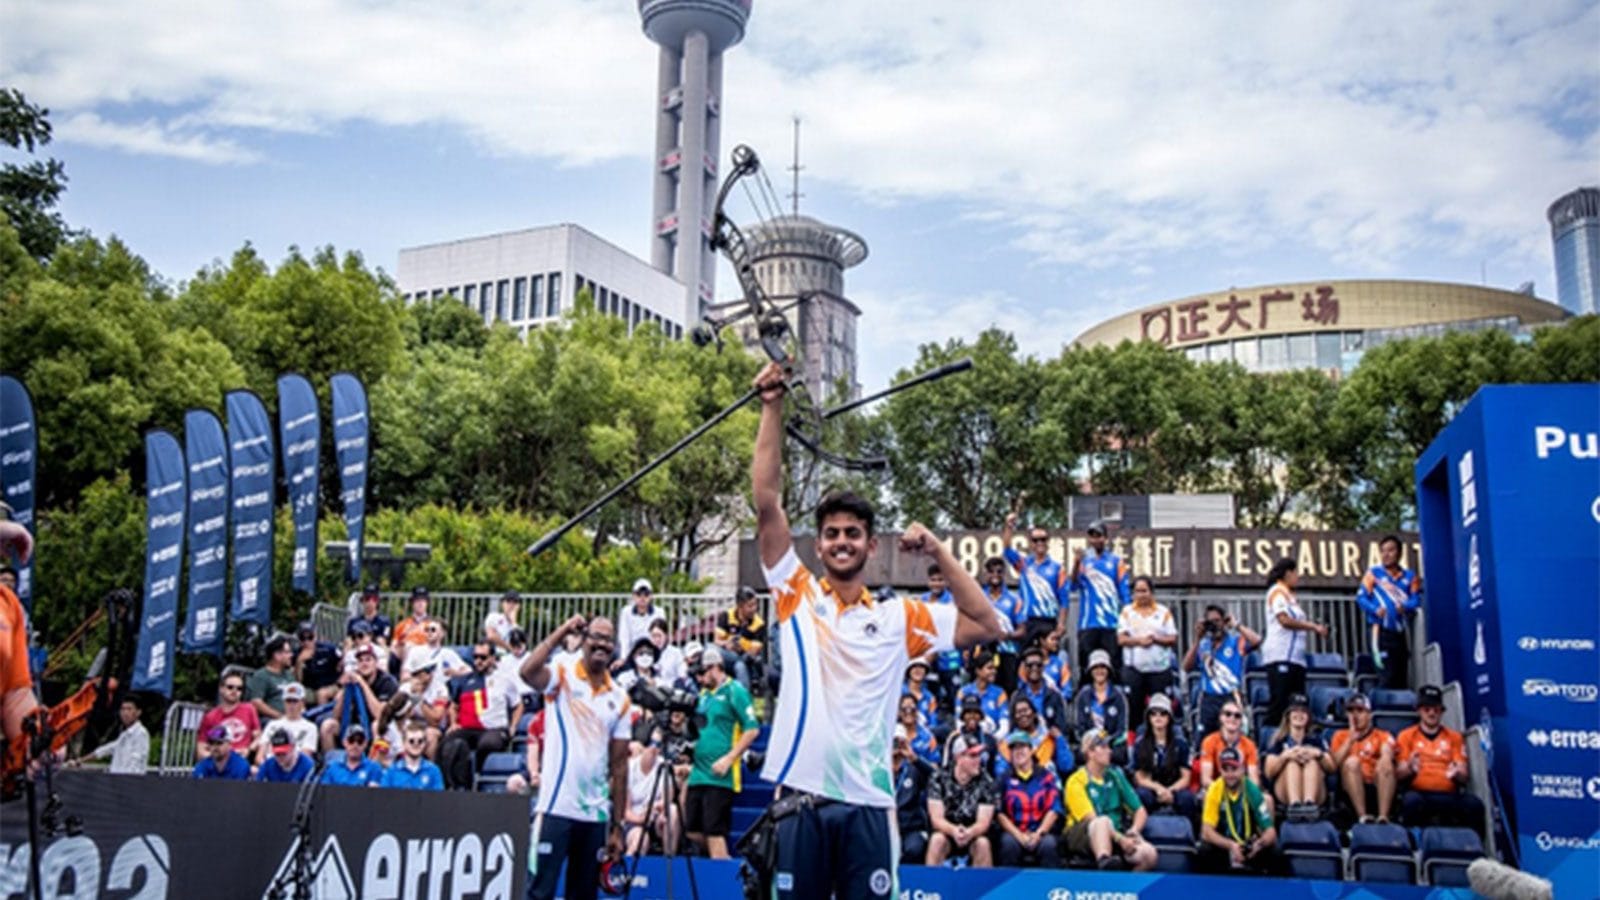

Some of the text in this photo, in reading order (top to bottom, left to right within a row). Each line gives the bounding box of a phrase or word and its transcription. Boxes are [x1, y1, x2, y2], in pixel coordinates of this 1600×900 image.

[1176, 285, 1340, 342] 正大广场
[1541, 639, 1594, 650] HYUNDAI
[1531, 774, 1582, 786] TURKISH
[1532, 786, 1584, 799] AIRLINES
